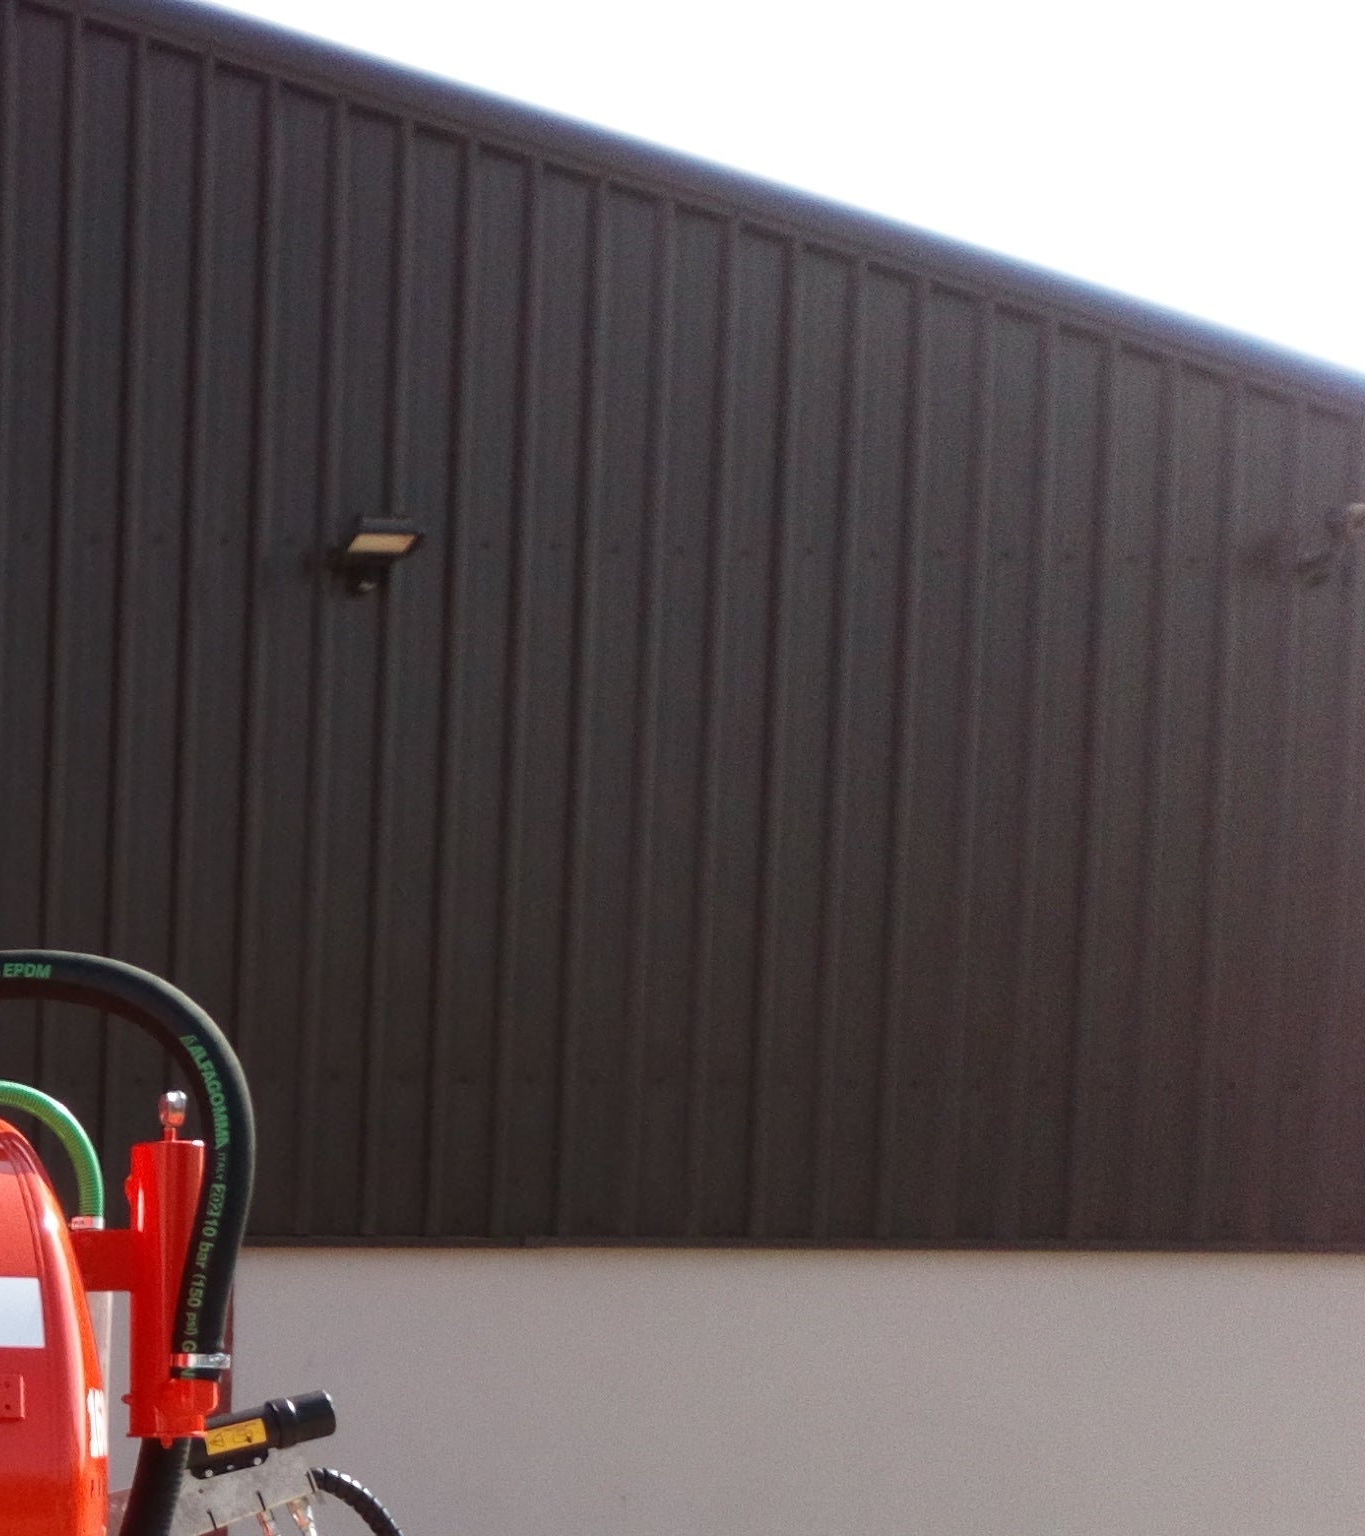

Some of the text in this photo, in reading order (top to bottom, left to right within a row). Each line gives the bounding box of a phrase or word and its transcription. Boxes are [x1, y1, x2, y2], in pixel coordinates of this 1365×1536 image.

[2, 962, 52, 978] EPDM
[186, 1042, 231, 1149] ALFAGOMMA
[203, 1217, 219, 1237] 10
[195, 1241, 214, 1268] bar
[187, 1273, 206, 1308] (150
